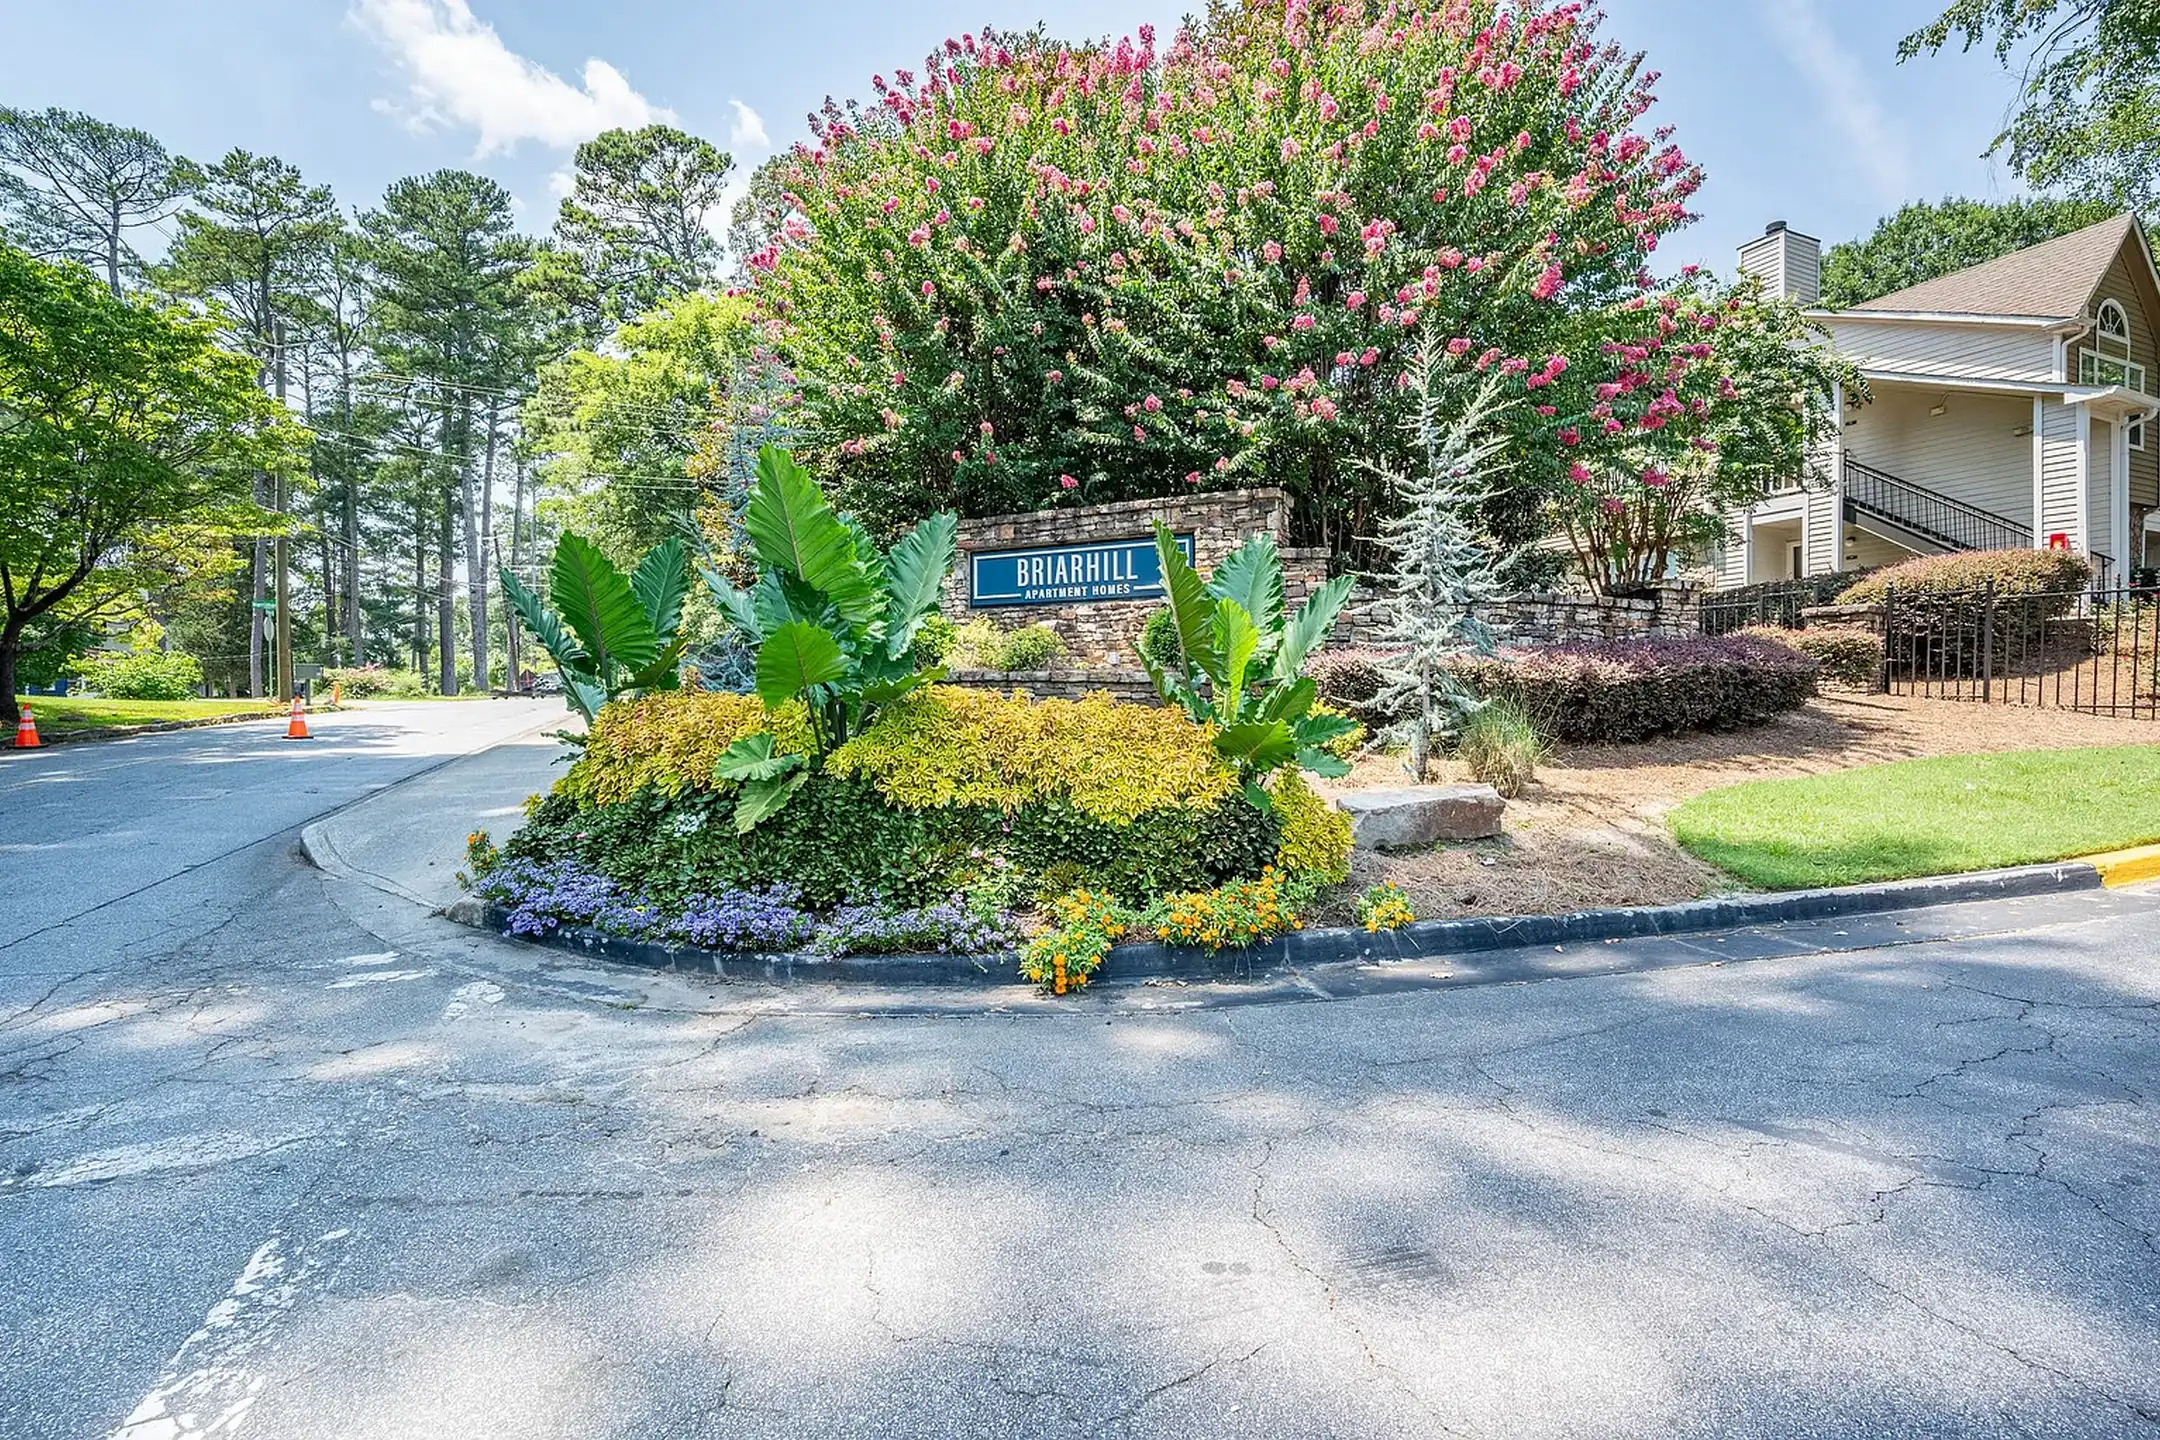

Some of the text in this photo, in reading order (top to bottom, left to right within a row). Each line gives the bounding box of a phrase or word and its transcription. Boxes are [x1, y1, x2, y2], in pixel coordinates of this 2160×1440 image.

[1017, 550, 1138, 587] BRIARHILL
[1024, 583, 1130, 599] APARTMENT HOMES
